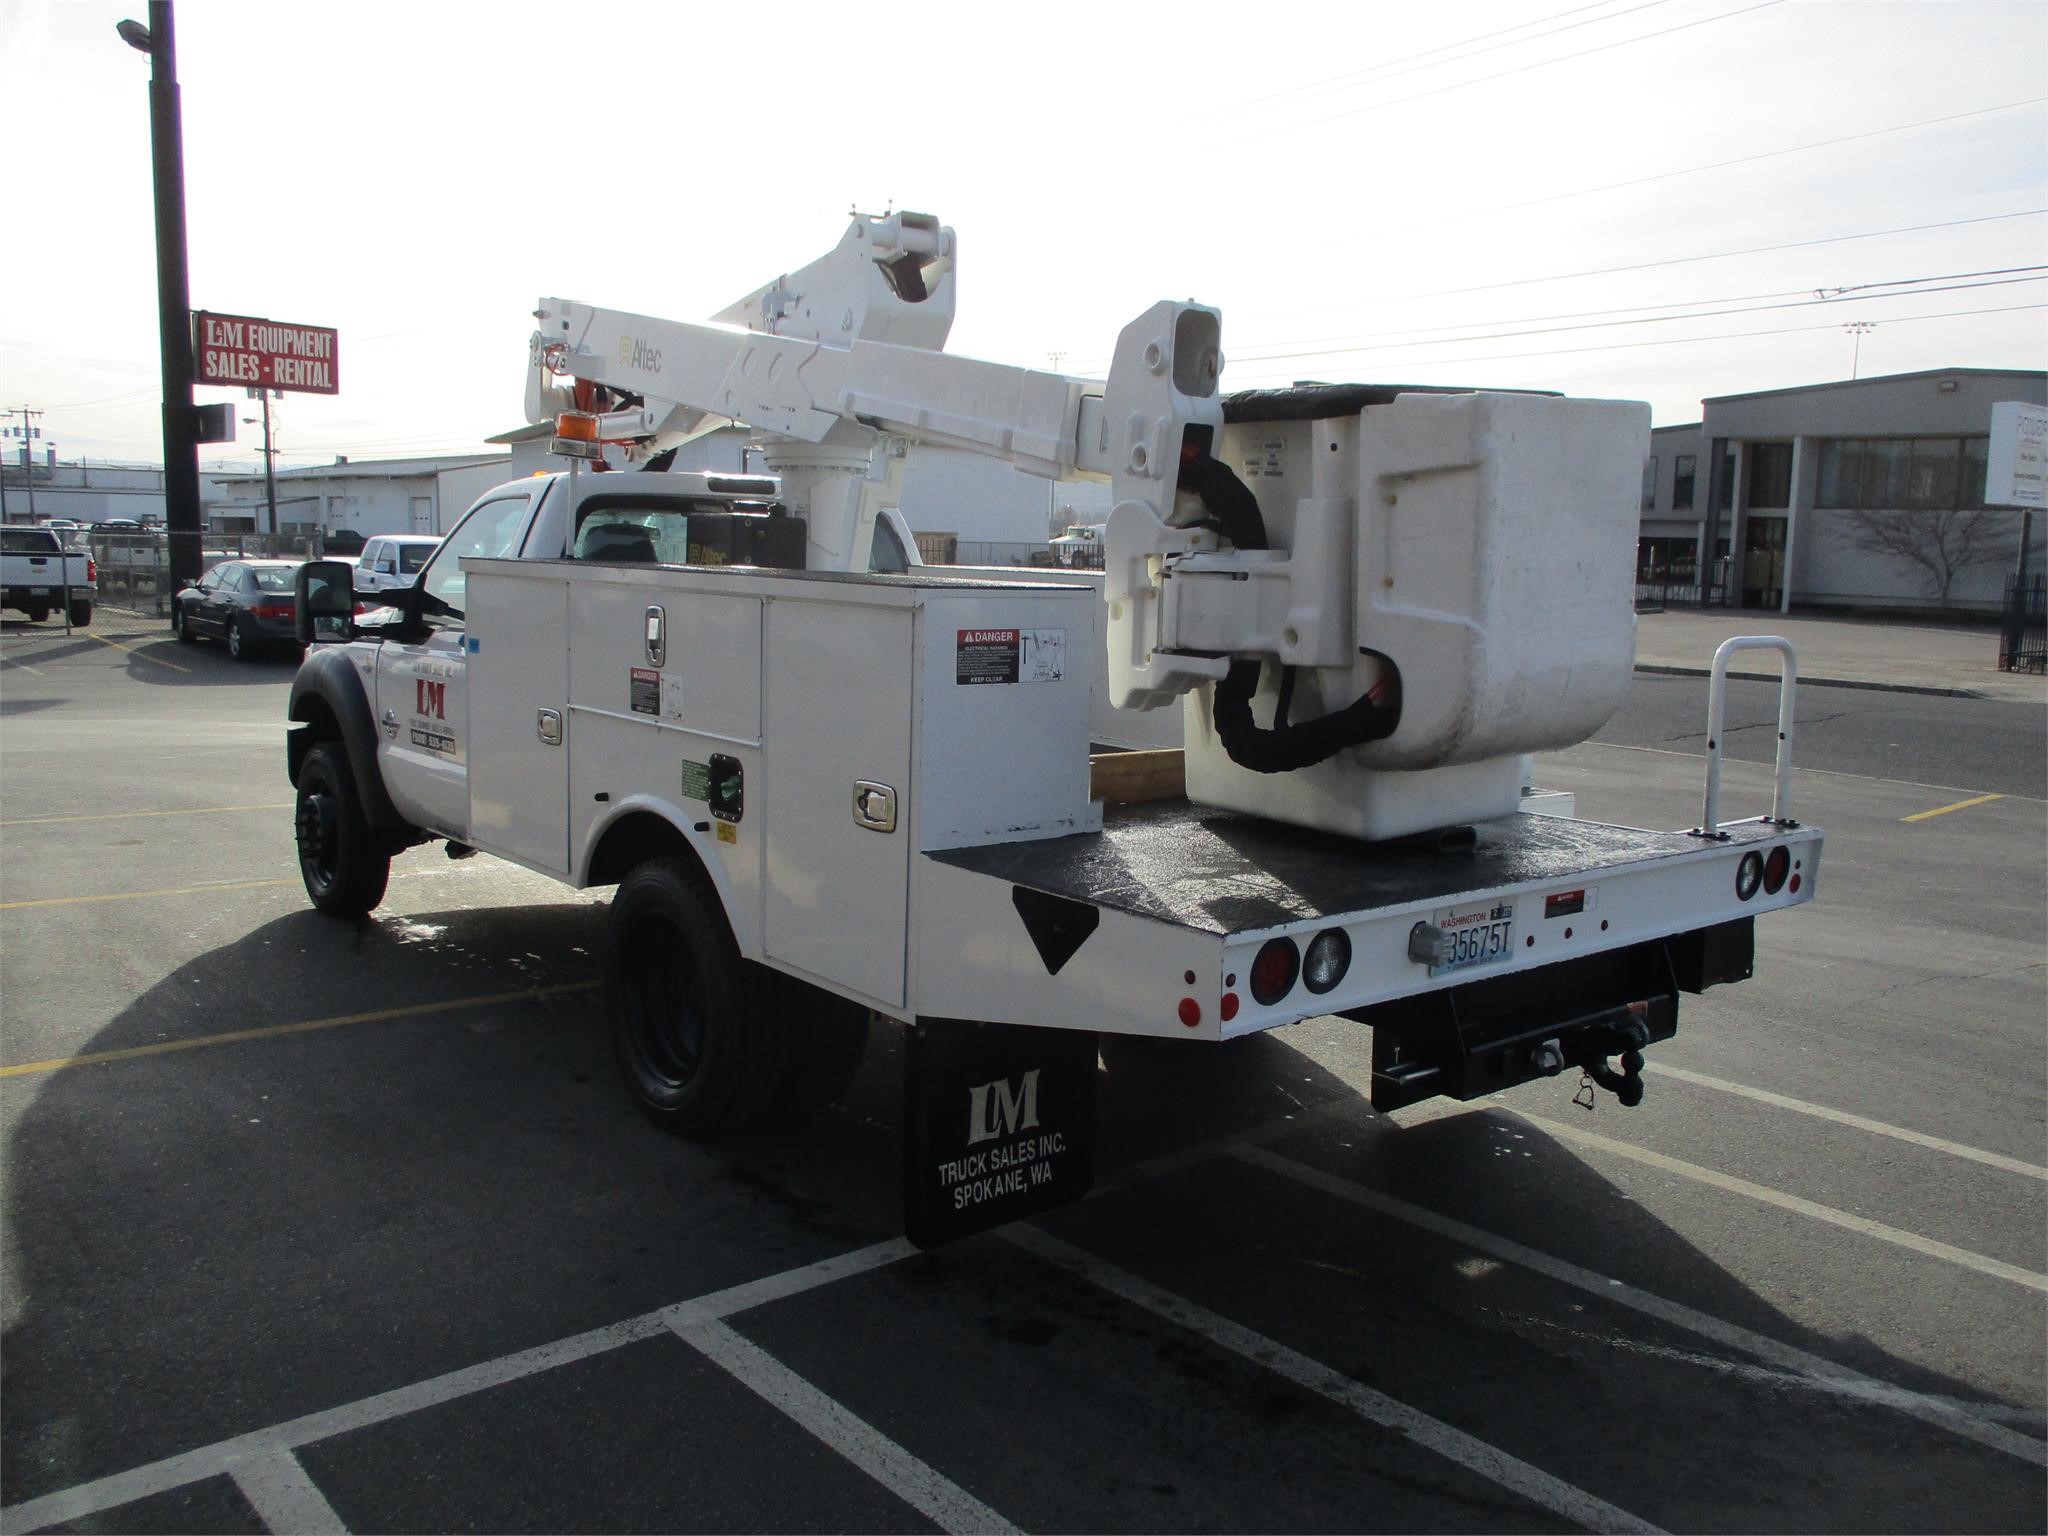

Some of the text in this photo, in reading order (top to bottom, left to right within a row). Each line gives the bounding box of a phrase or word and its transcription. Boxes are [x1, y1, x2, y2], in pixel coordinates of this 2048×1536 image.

[248, 325, 332, 359] EQUIPMENT
[631, 338, 662, 374] Altec
[206, 351, 332, 388] SALES RENTAL
[975, 631, 1013, 642] DANGER
[1440, 912, 1486, 928] WASHINGTON
[938, 1132, 1066, 1186] TRUCK SALES INC.
[954, 1160, 1052, 1209] SPOKANE, WA
